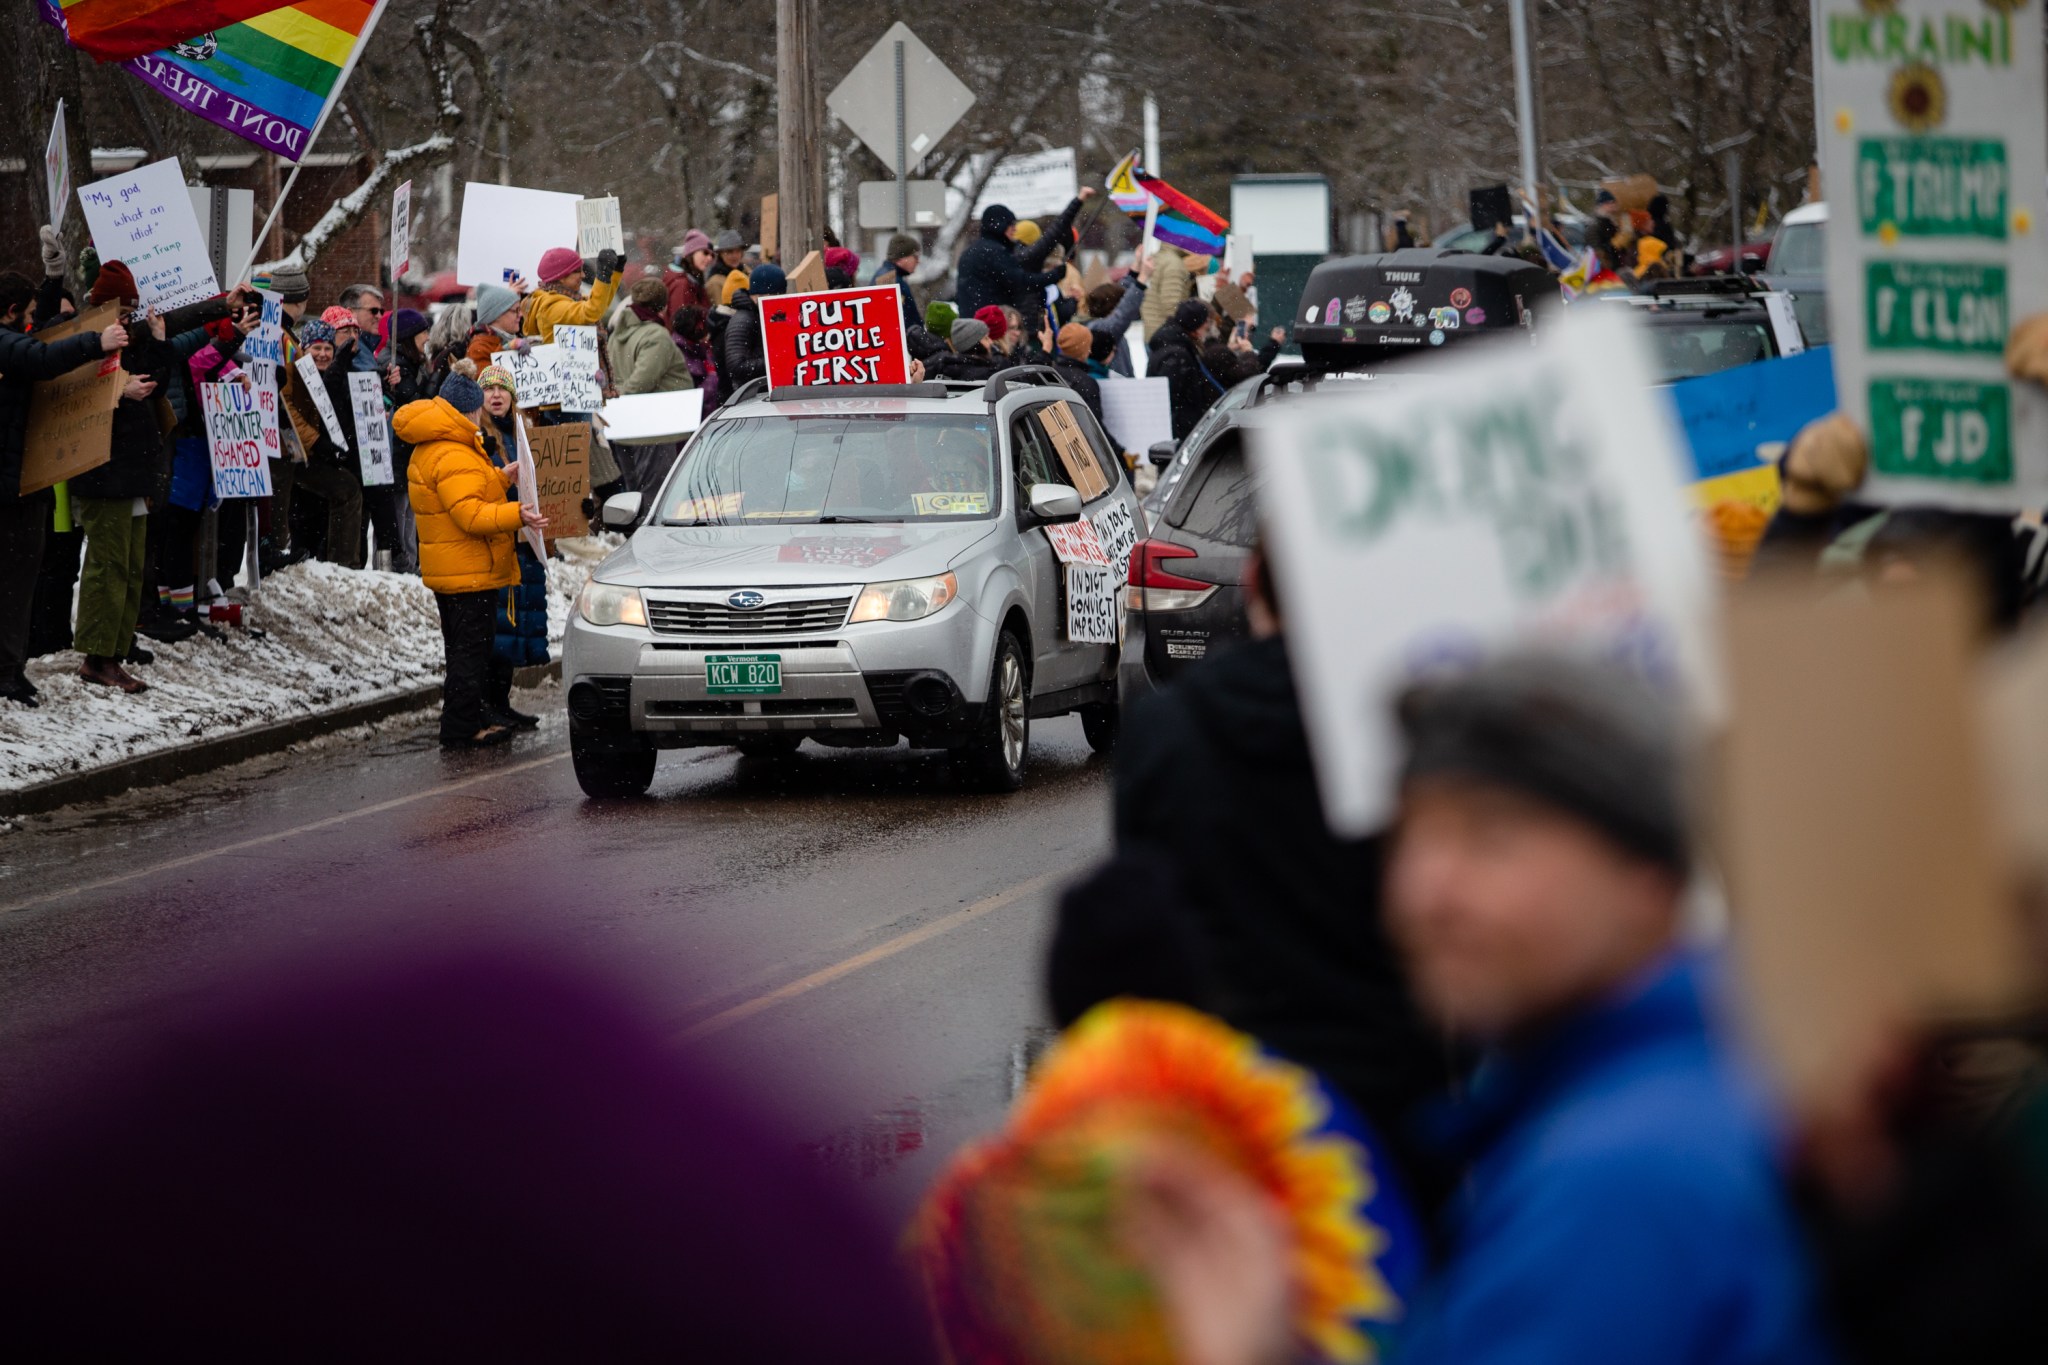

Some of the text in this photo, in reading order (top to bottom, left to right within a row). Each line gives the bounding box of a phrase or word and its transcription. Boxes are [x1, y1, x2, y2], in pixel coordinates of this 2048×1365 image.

[114, 204, 165, 227] what an
[153, 241, 182, 256] Trump
[1385, 271, 1420, 282] THULE
[801, 297, 872, 328] PUT
[796, 326, 884, 358] PEOPLE
[252, 361, 269, 385] NOT
[510, 352, 539, 370] WAS
[795, 355, 881, 386] FIRST
[514, 368, 548, 388] FRAID
[205, 383, 253, 413] PROUD
[208, 411, 265, 440] VERMONTER
[214, 440, 260, 468] ASHAMED
[529, 434, 582, 469] SAVE
[215, 468, 266, 496] AMERICAN
[537, 475, 582, 497] dicaid
[914, 494, 987, 515] LOVE
[1107, 502, 1130, 533] YOUR
[1116, 531, 1129, 553] OUT
[1128, 527, 1137, 543] OF
[1072, 569, 1107, 594] INDICT
[1071, 593, 1112, 617] CONVICT
[1071, 616, 1113, 639] IMPRISON
[1160, 629, 1210, 638] SUBARU
[748, 664, 775, 684] 820
